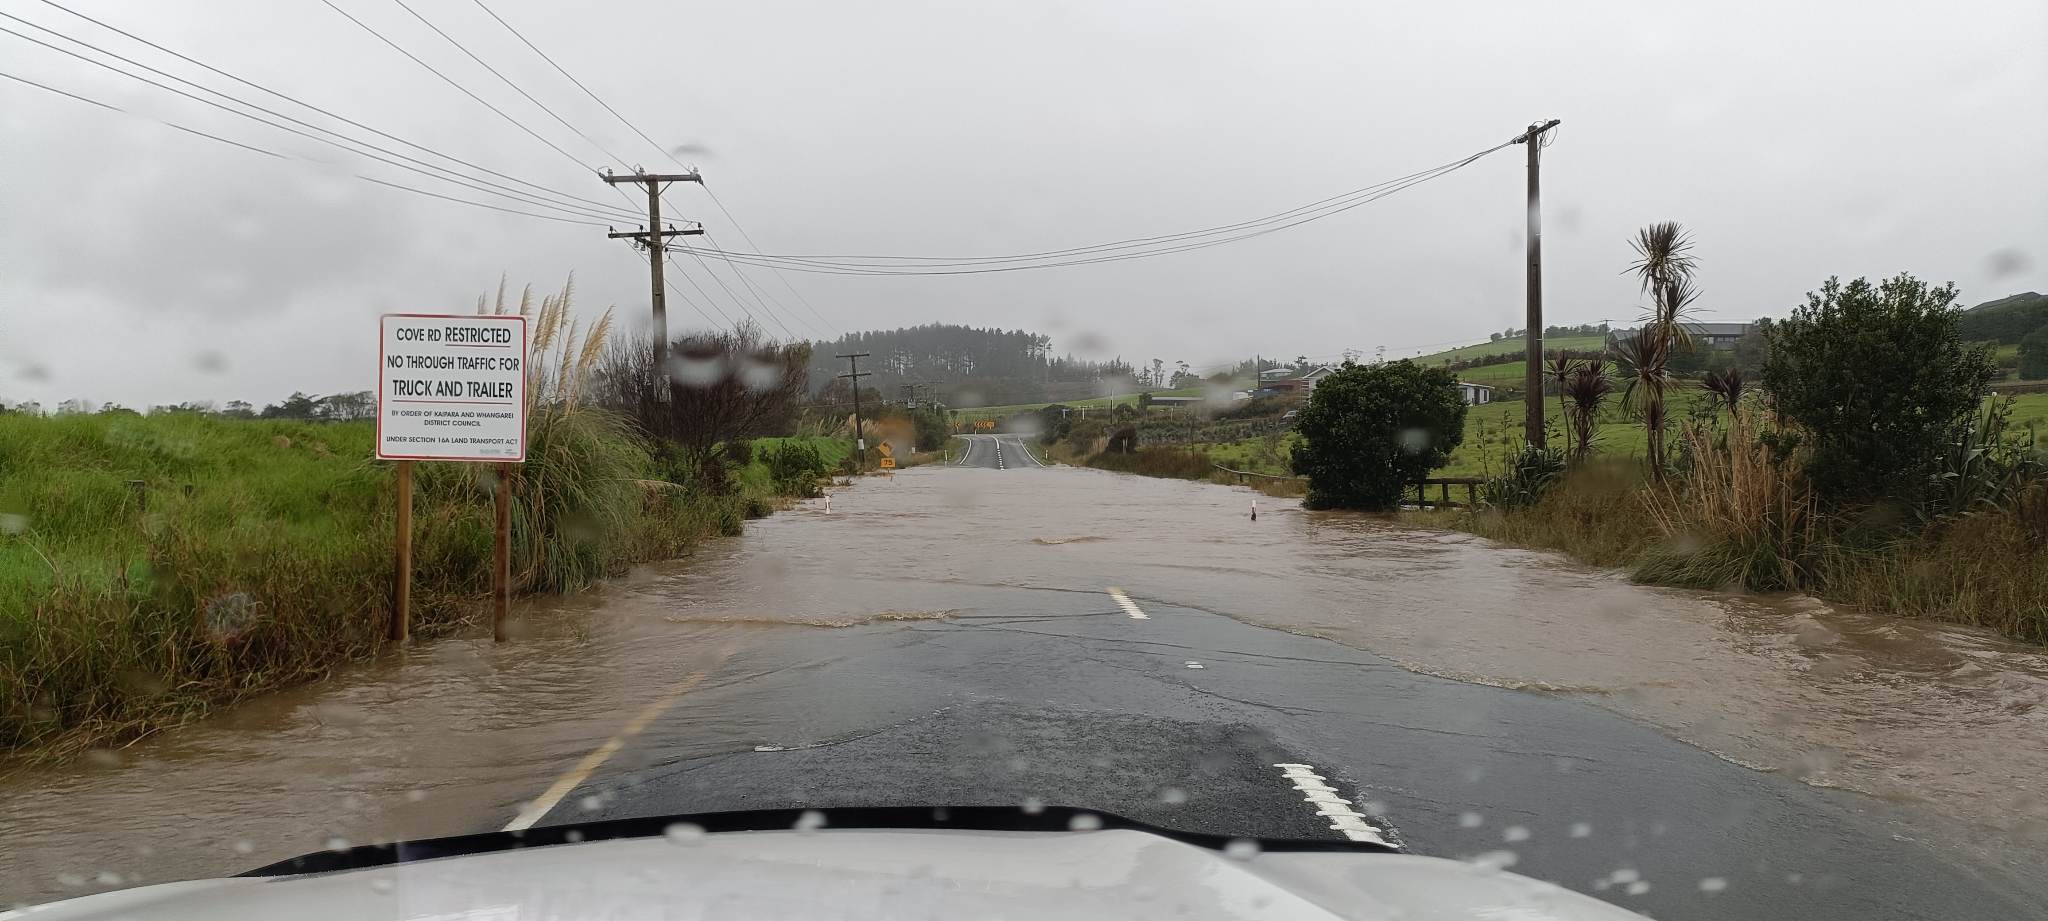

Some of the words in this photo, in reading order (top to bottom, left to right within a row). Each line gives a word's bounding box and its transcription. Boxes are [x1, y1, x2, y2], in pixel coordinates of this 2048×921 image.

[397, 328, 424, 341] COVE
[428, 329, 441, 341] RD
[445, 327, 510, 343] RESTRICTED
[388, 355, 403, 368] NO
[407, 356, 454, 369] THROUGH
[458, 357, 495, 370] TRAFFIC
[500, 358, 519, 370] FOR
[393, 380, 432, 396] TRUCK
[436, 381, 463, 396] AND
[467, 382, 512, 398] TRAILER
